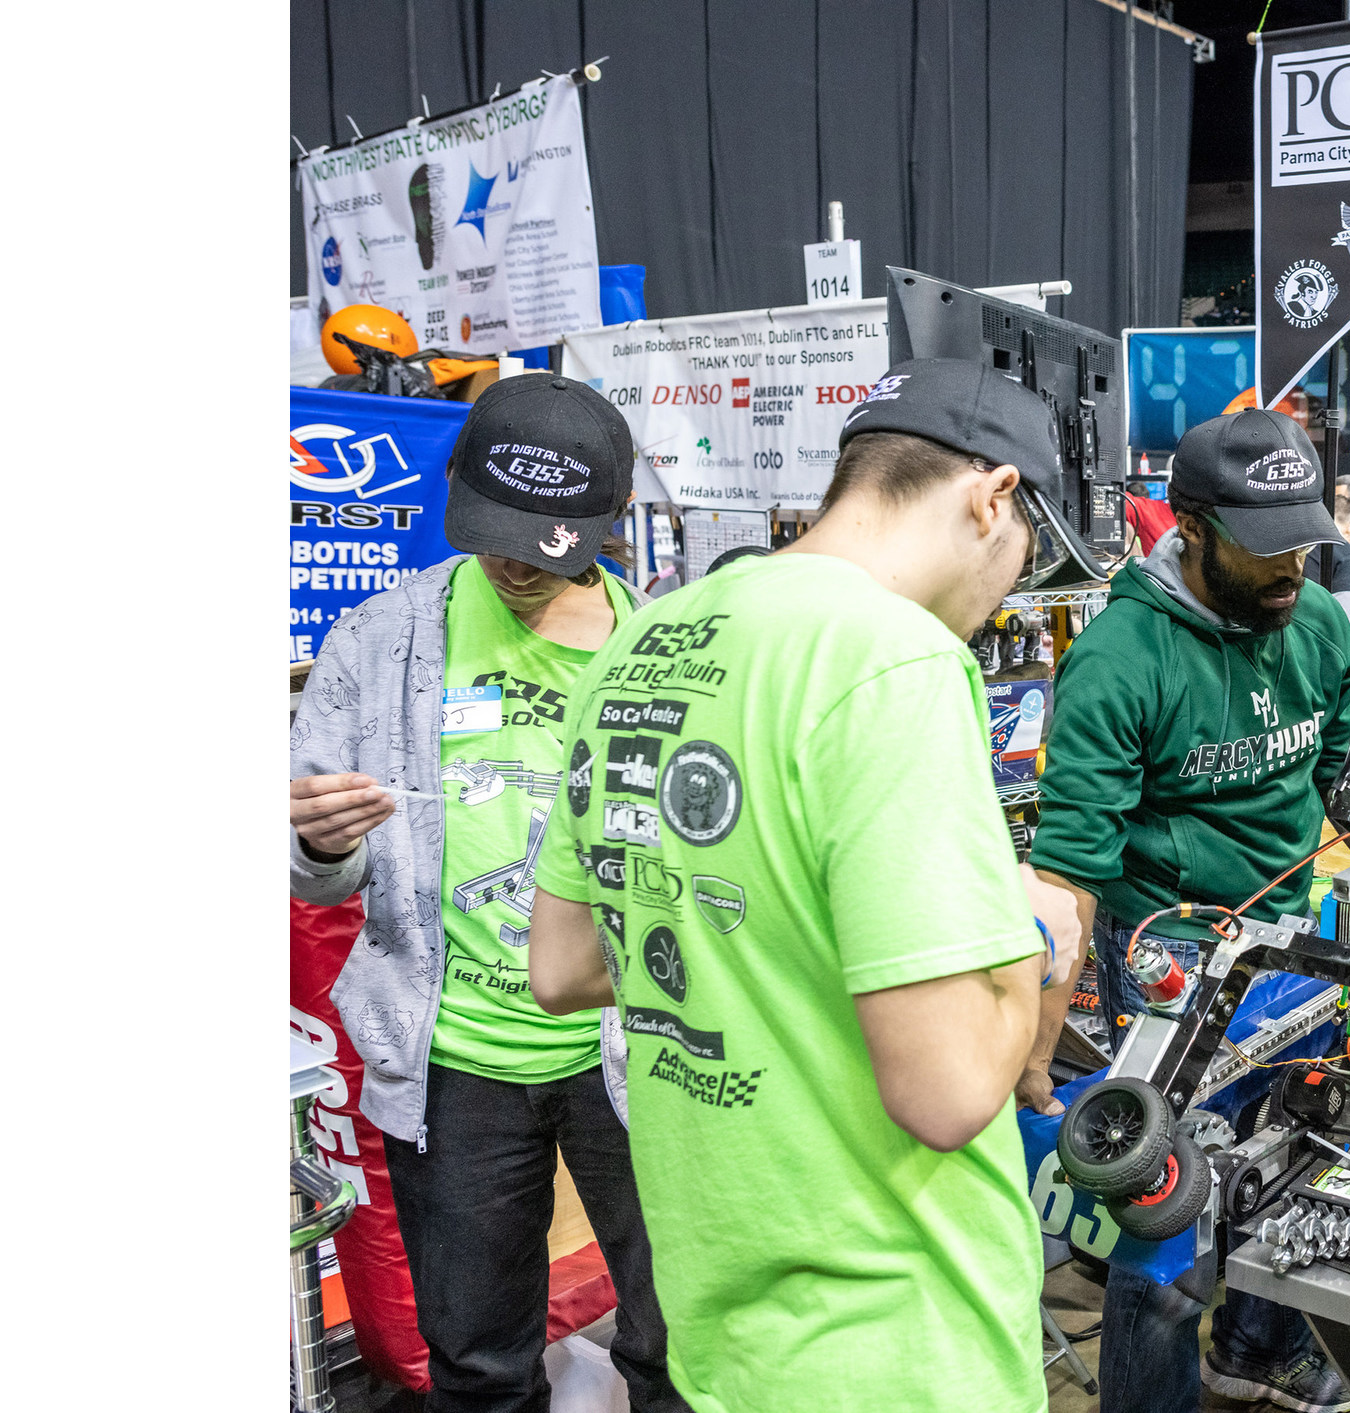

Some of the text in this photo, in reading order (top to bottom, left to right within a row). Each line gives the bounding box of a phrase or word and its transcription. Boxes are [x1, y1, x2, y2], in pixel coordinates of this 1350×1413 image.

[312, 91, 548, 181] NORTHWEST STATE CRYPTIC CYBORGS
[1280, 149, 1325, 166] Parma
[818, 248, 838, 259] TEAM
[1277, 259, 1335, 288] VALLEY FORGE
[810, 275, 851, 299] 1014
[427, 310, 445, 324] DEEP
[1283, 311, 1329, 329] PATRIOTS
[613, 344, 642, 357] Dublin
[645, 339, 687, 352] Robotics
[689, 336, 711, 350] FRC
[714, 336, 740, 348] team
[768, 329, 803, 344] Dublin
[805, 326, 829, 341] FTC
[832, 325, 854, 340] and
[857, 323, 879, 338] FLL
[765, 354, 775, 366] to
[778, 353, 797, 365] our
[800, 350, 854, 367] Sponsors
[651, 384, 722, 405] DENSO
[753, 385, 804, 398] AMERICAN
[816, 385, 876, 404] HON
[753, 400, 793, 412] ELECTRIC
[753, 415, 785, 426] POWER
[490, 444, 591, 477] 1ST DIGITAL TWIN
[647, 452, 678, 467] rizon
[701, 457, 716, 468] City
[754, 449, 783, 470] roto
[1246, 460, 1261, 476] 1ST
[1262, 449, 1298, 465] DIGITAL
[486, 460, 589, 497] MAKING HISTORY
[508, 457, 569, 484] 6355
[1266, 462, 1304, 480] 6355
[679, 485, 723, 499] Hidaka
[725, 487, 744, 499] USA
[746, 488, 760, 500] Inc.
[1247, 479, 1290, 491] MAKING
[290, 500, 423, 530] RST
[290, 540, 399, 566] BOTICS
[290, 608, 323, 625] 014
[985, 686, 1012, 696] pstart
[1178, 711, 1326, 778] MERCYHURT
[454, 967, 484, 988] 1st
